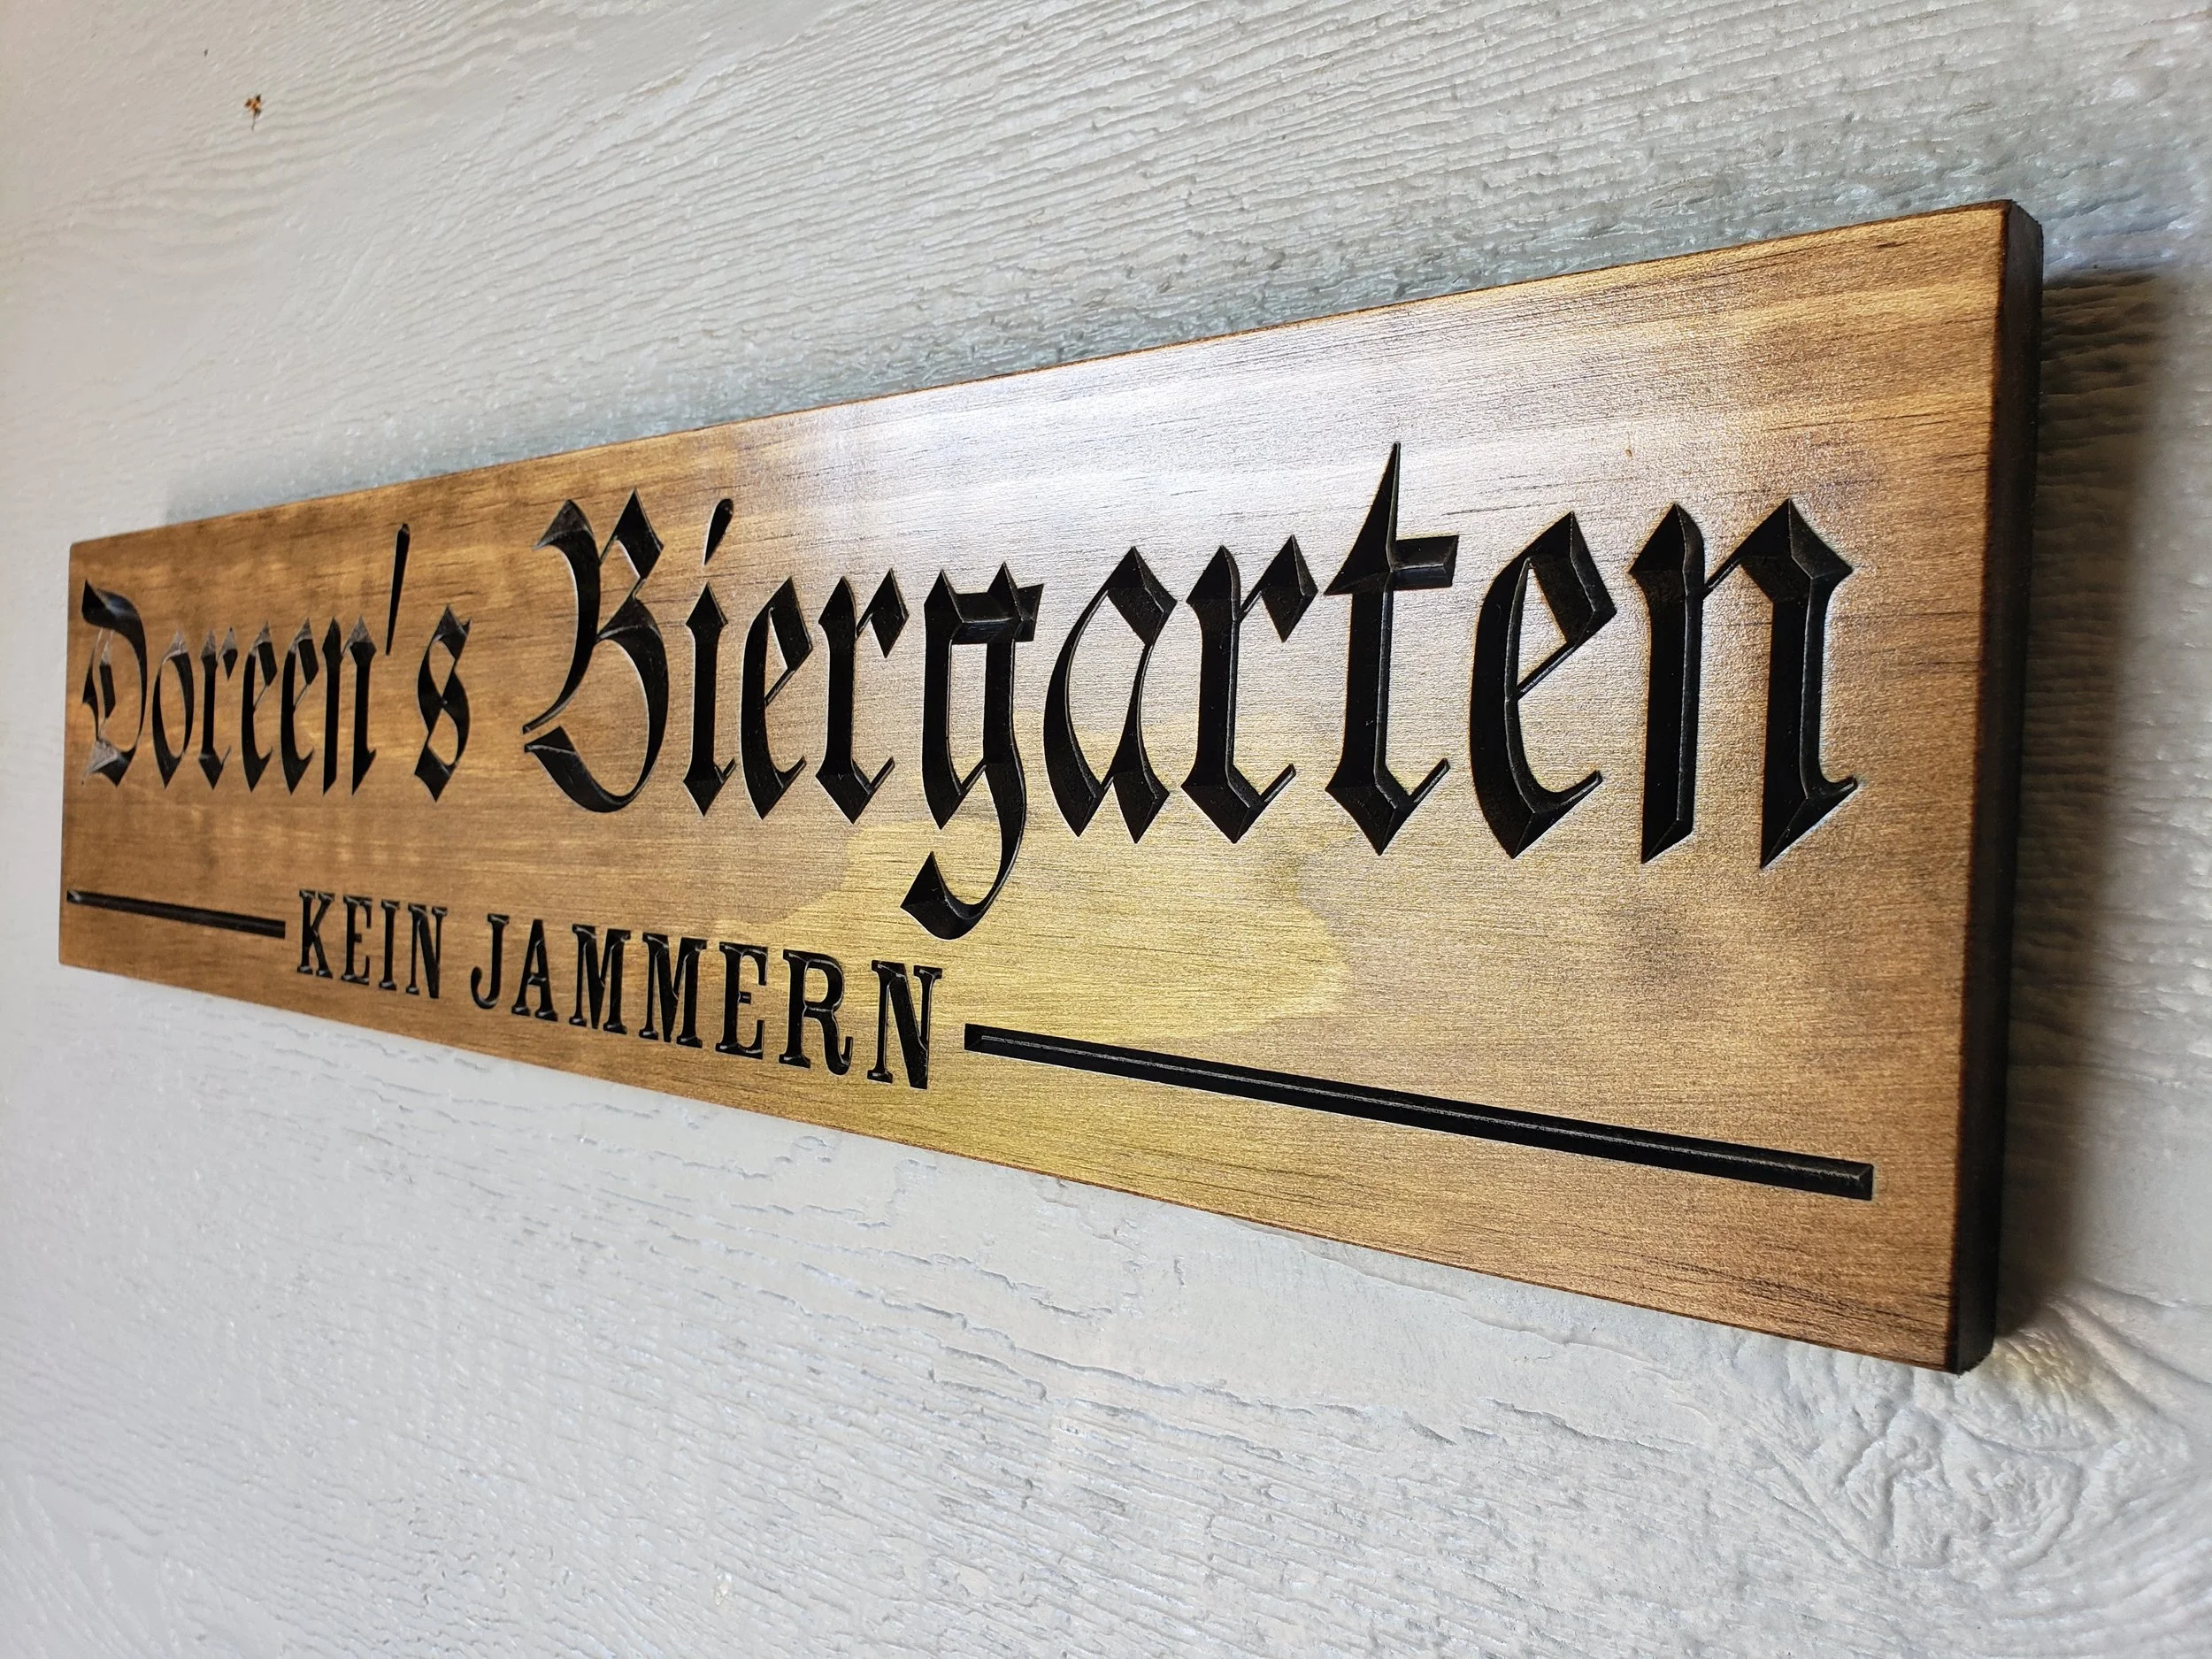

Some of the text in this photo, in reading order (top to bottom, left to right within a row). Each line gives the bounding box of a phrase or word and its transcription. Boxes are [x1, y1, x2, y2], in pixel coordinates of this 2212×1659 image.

[81, 442, 1859, 940] Doreen's Biergarten
[296, 888, 943, 1090] KEIN JAMMERN
